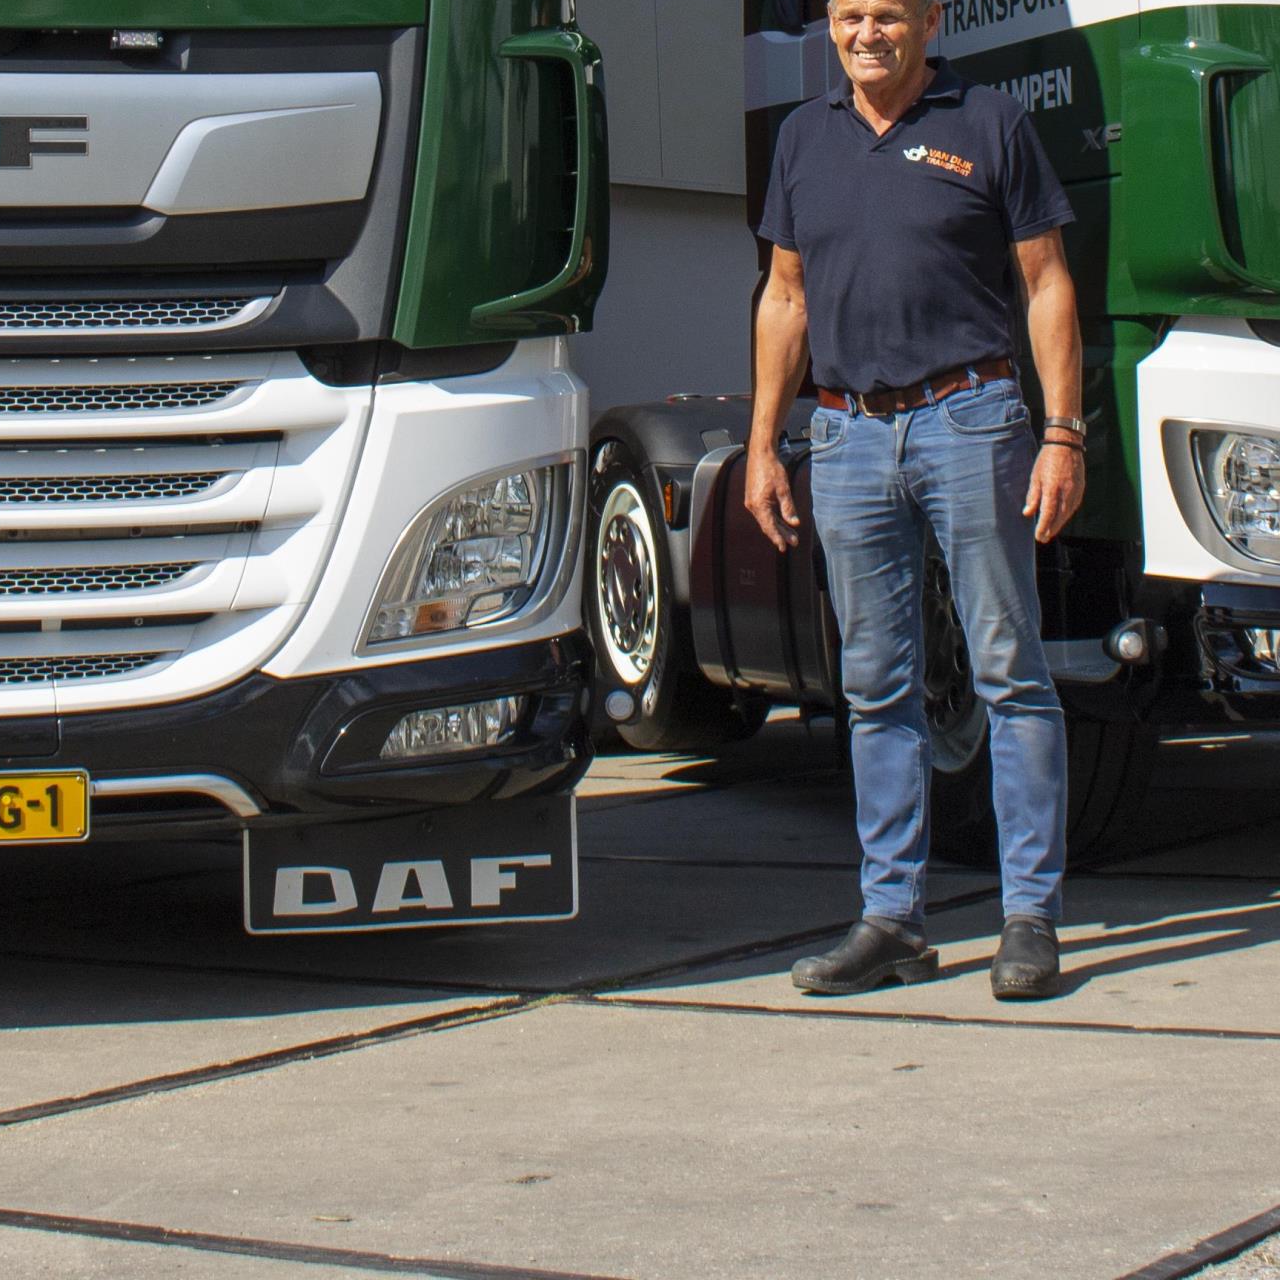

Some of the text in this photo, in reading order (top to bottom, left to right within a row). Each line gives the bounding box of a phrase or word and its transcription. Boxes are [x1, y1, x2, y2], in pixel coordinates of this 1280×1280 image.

[991, 66, 1073, 112] MPEN
[929, 148, 974, 171] VAN DIJK
[273, 854, 552, 916] DAF
